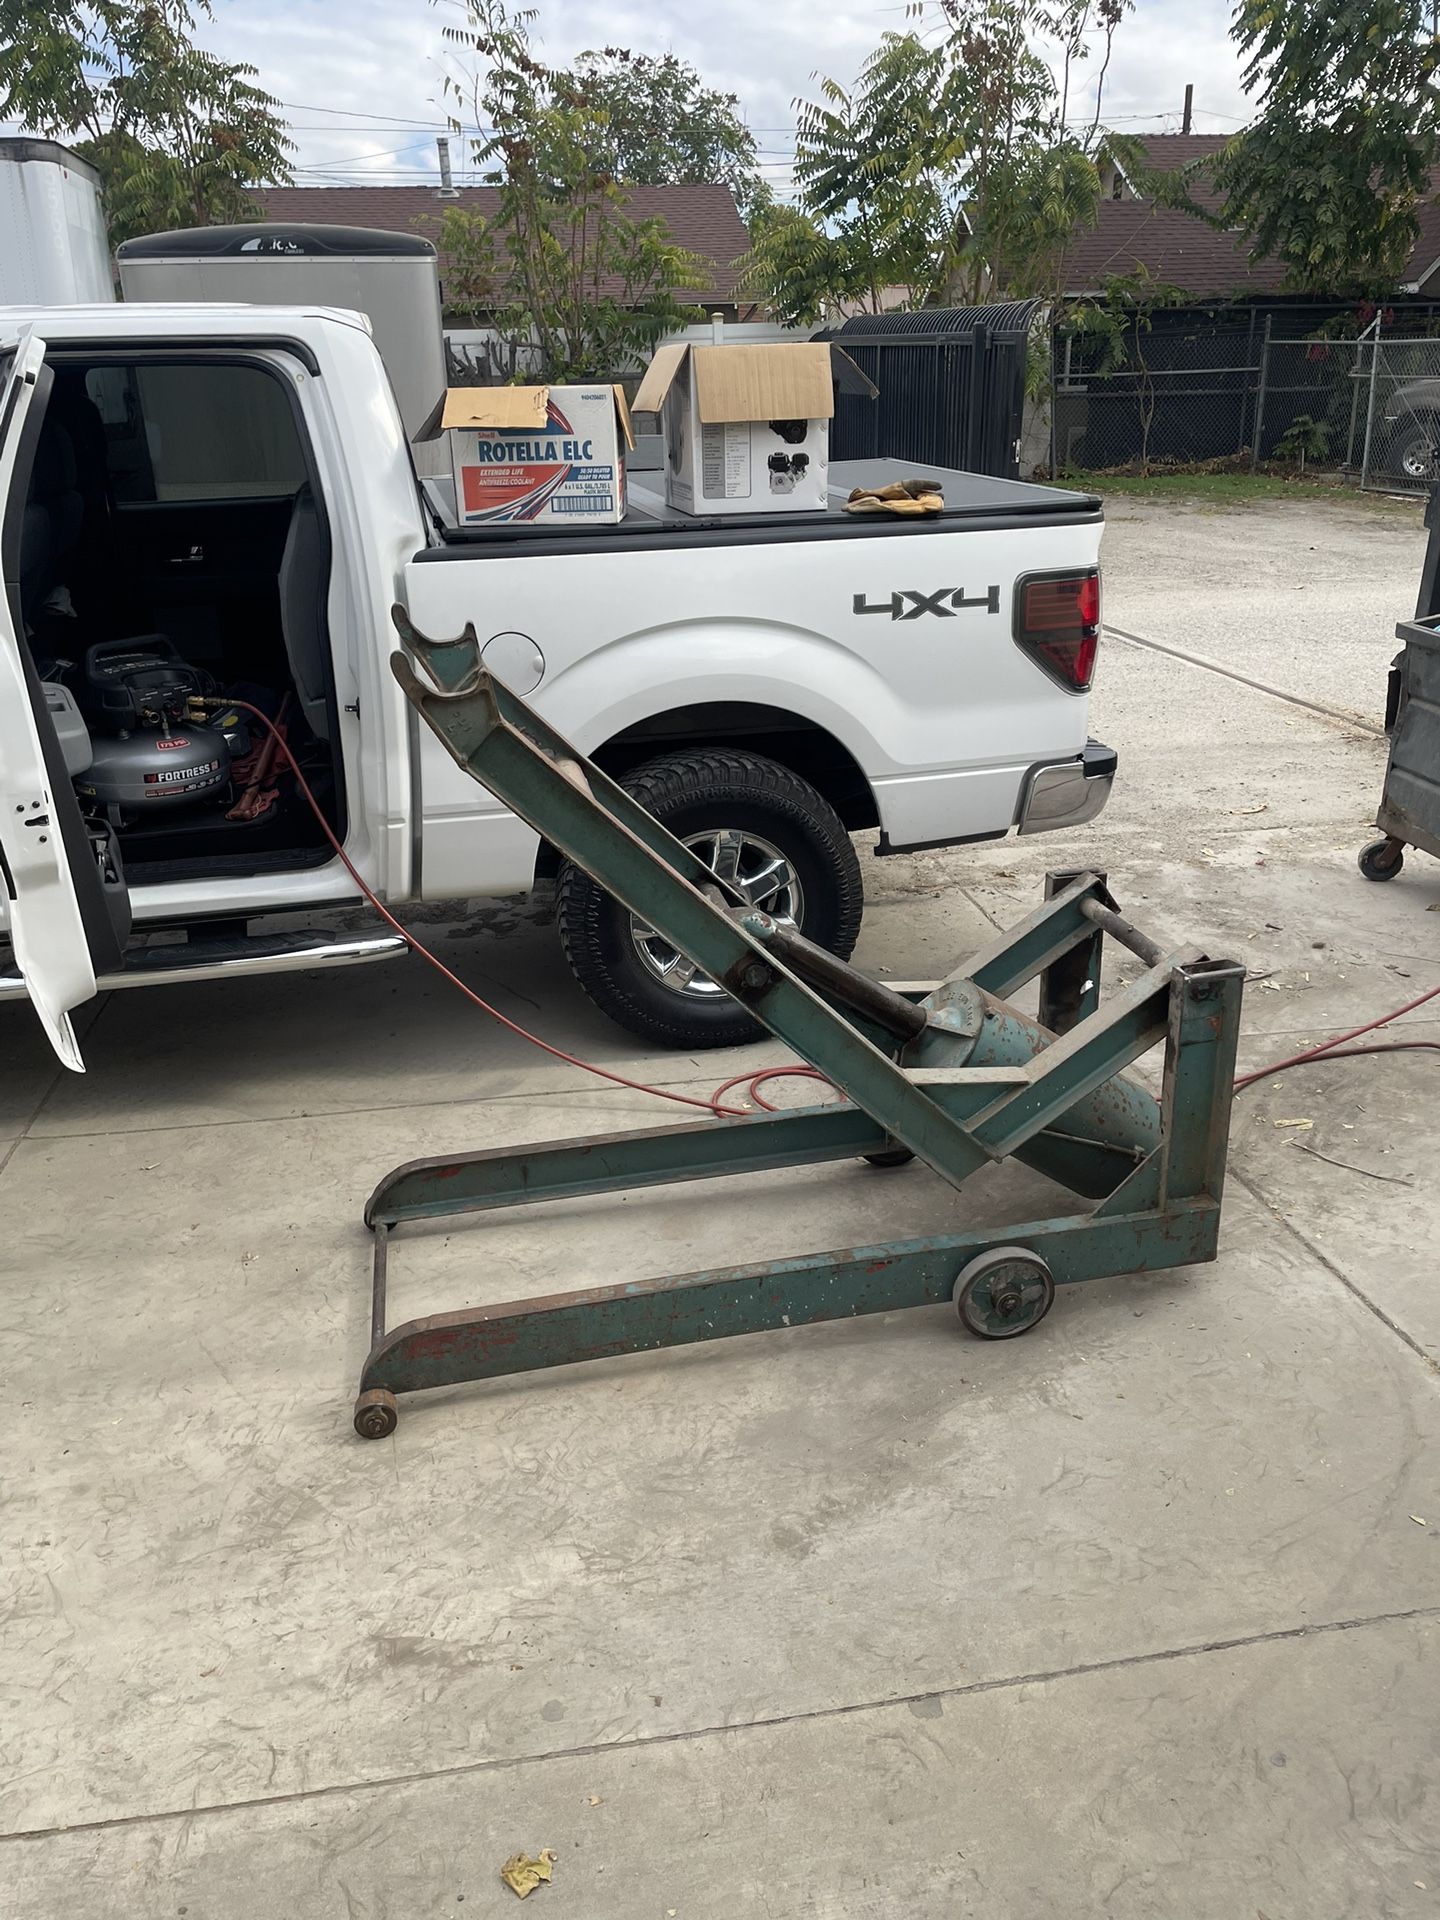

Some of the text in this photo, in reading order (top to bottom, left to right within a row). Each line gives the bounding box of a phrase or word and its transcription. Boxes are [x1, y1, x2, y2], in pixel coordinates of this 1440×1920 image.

[478, 440, 593, 462] ROTELLA ELC
[480, 468, 525, 476] EXTENDED LIFE
[853, 585, 1000, 621] 4X4
[158, 763, 211, 782] FORTRESS
